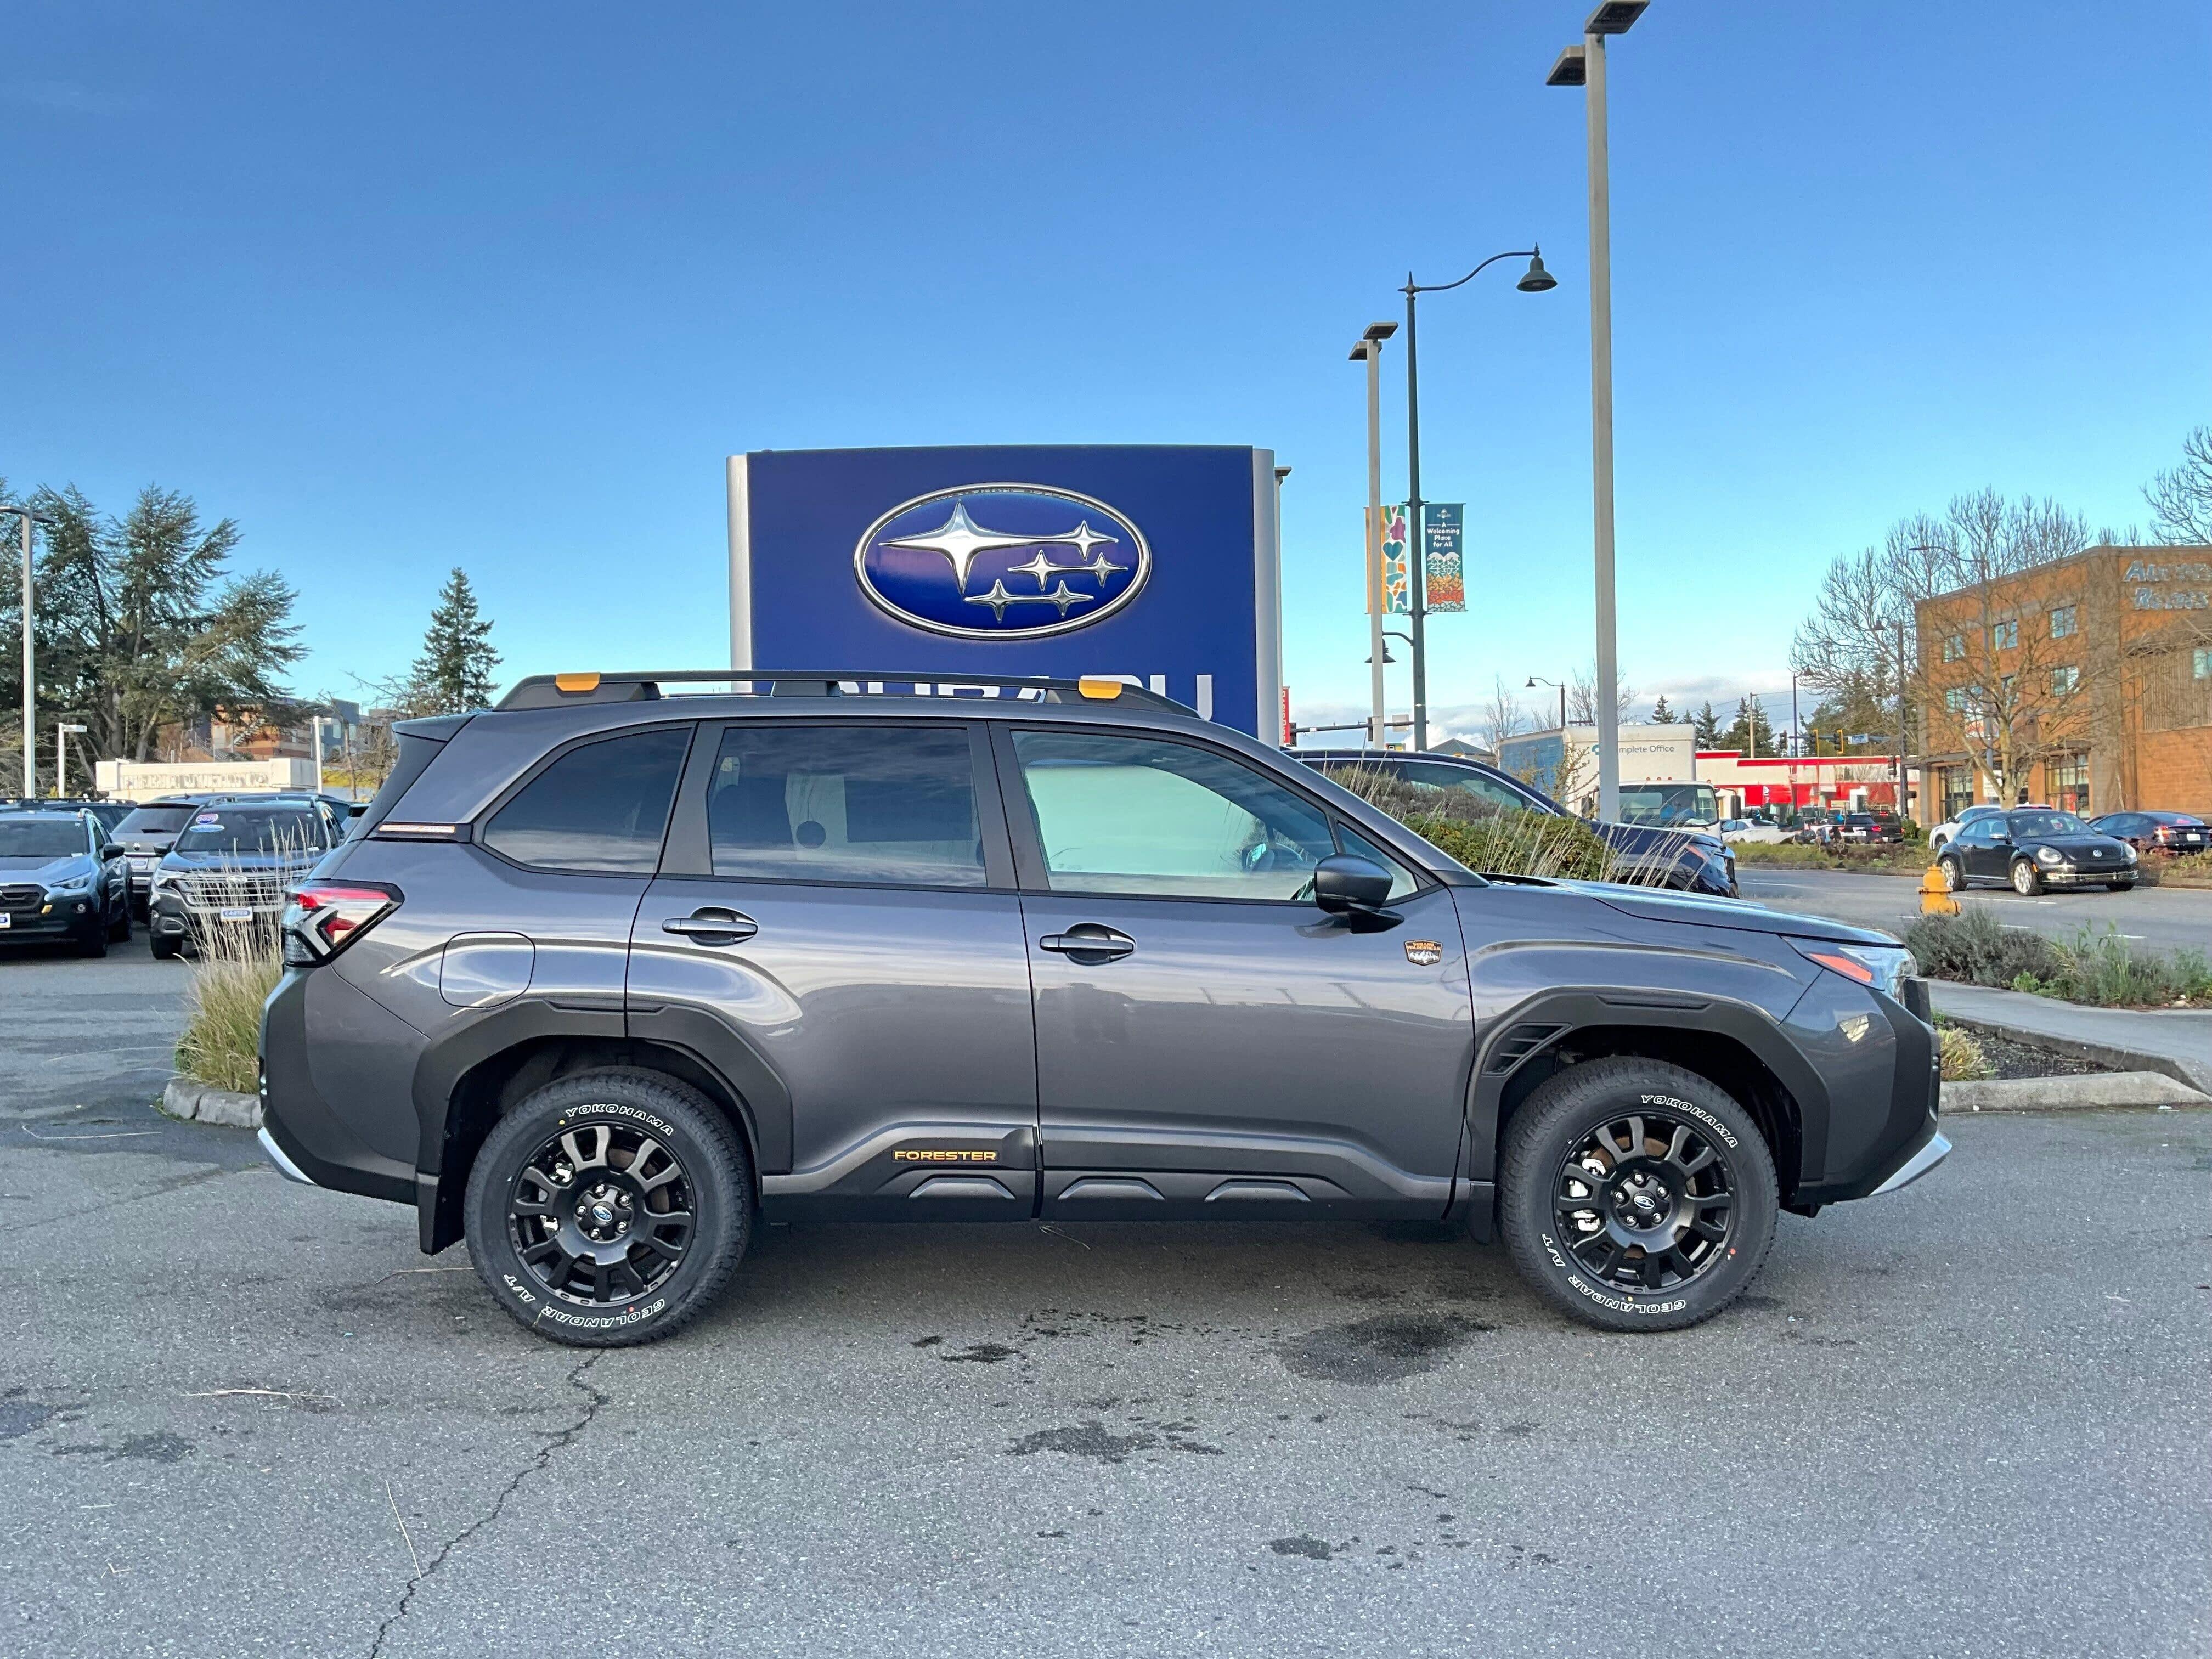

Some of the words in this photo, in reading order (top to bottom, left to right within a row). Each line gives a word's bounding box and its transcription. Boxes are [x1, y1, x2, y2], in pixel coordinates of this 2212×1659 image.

[1619, 746, 1647, 755] mplete
[1649, 744, 1674, 753] Office
[565, 1104, 674, 1136] YOKOHAMA
[1641, 1094, 1739, 1148] YOKOHAMA
[894, 1150, 997, 1161] FORESTER
[1542, 1234, 1566, 1267] A/T
[503, 1274, 536, 1302] A/T
[1568, 1274, 1686, 1314] GEOLANDAR
[541, 1299, 666, 1328] GEOLANDAR
